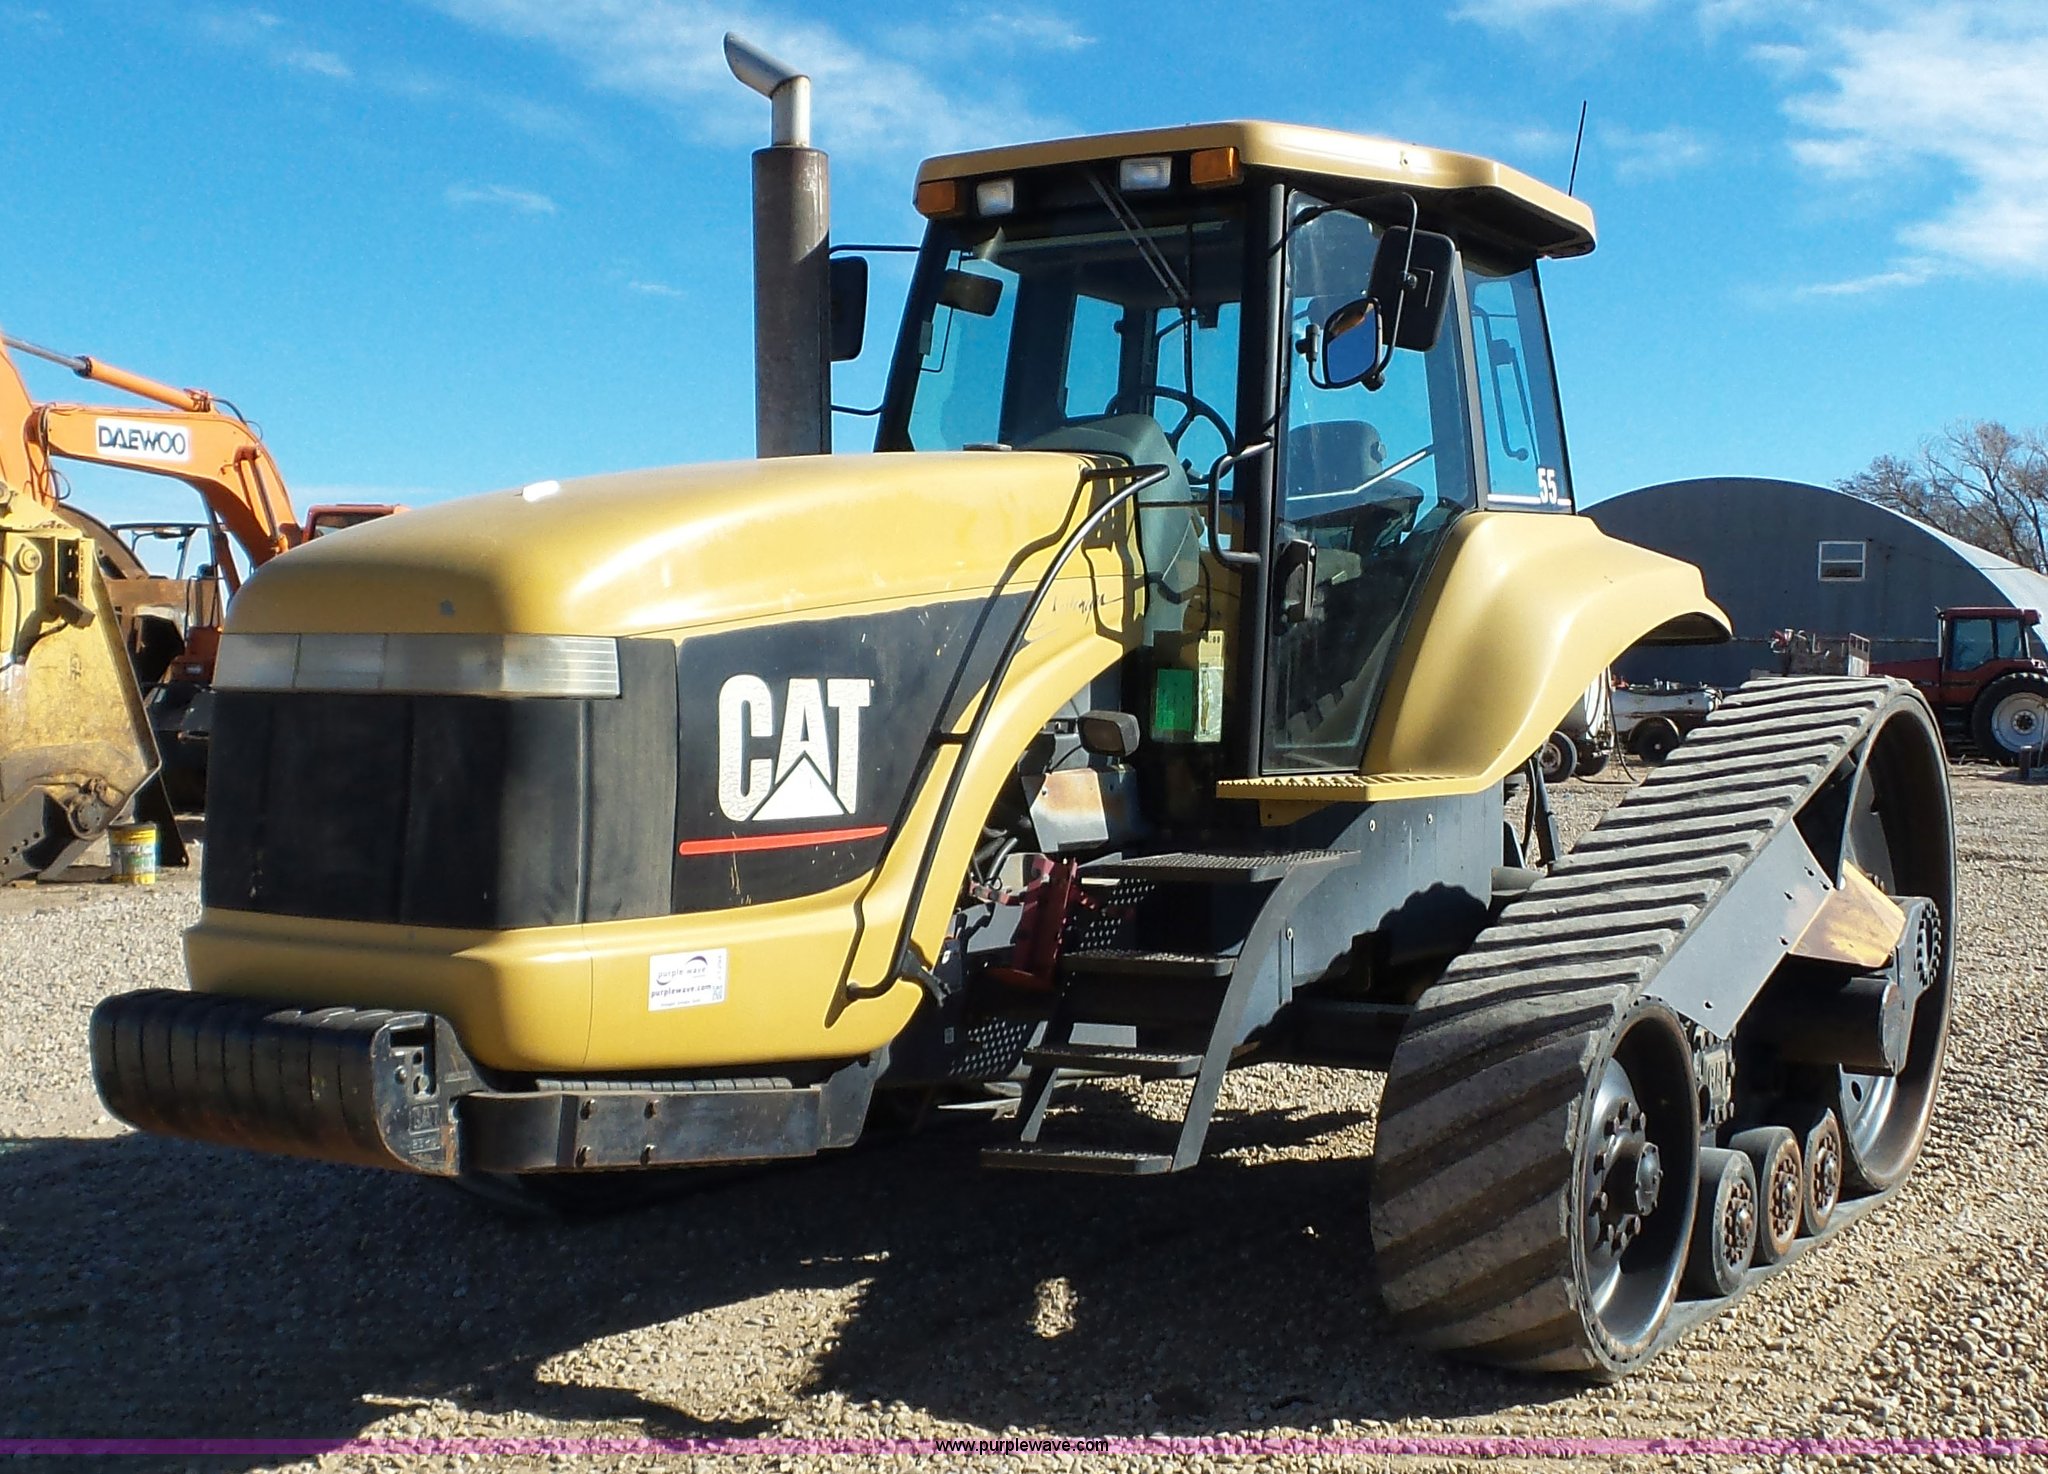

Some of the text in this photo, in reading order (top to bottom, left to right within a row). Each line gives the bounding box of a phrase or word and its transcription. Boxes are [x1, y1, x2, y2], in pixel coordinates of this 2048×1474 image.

[98, 425, 186, 455] DAEWOO
[1537, 467, 1558, 505] 55
[718, 674, 870, 822] CAT
[658, 968, 683, 979] purple
[651, 984, 712, 998] purplewave.com
